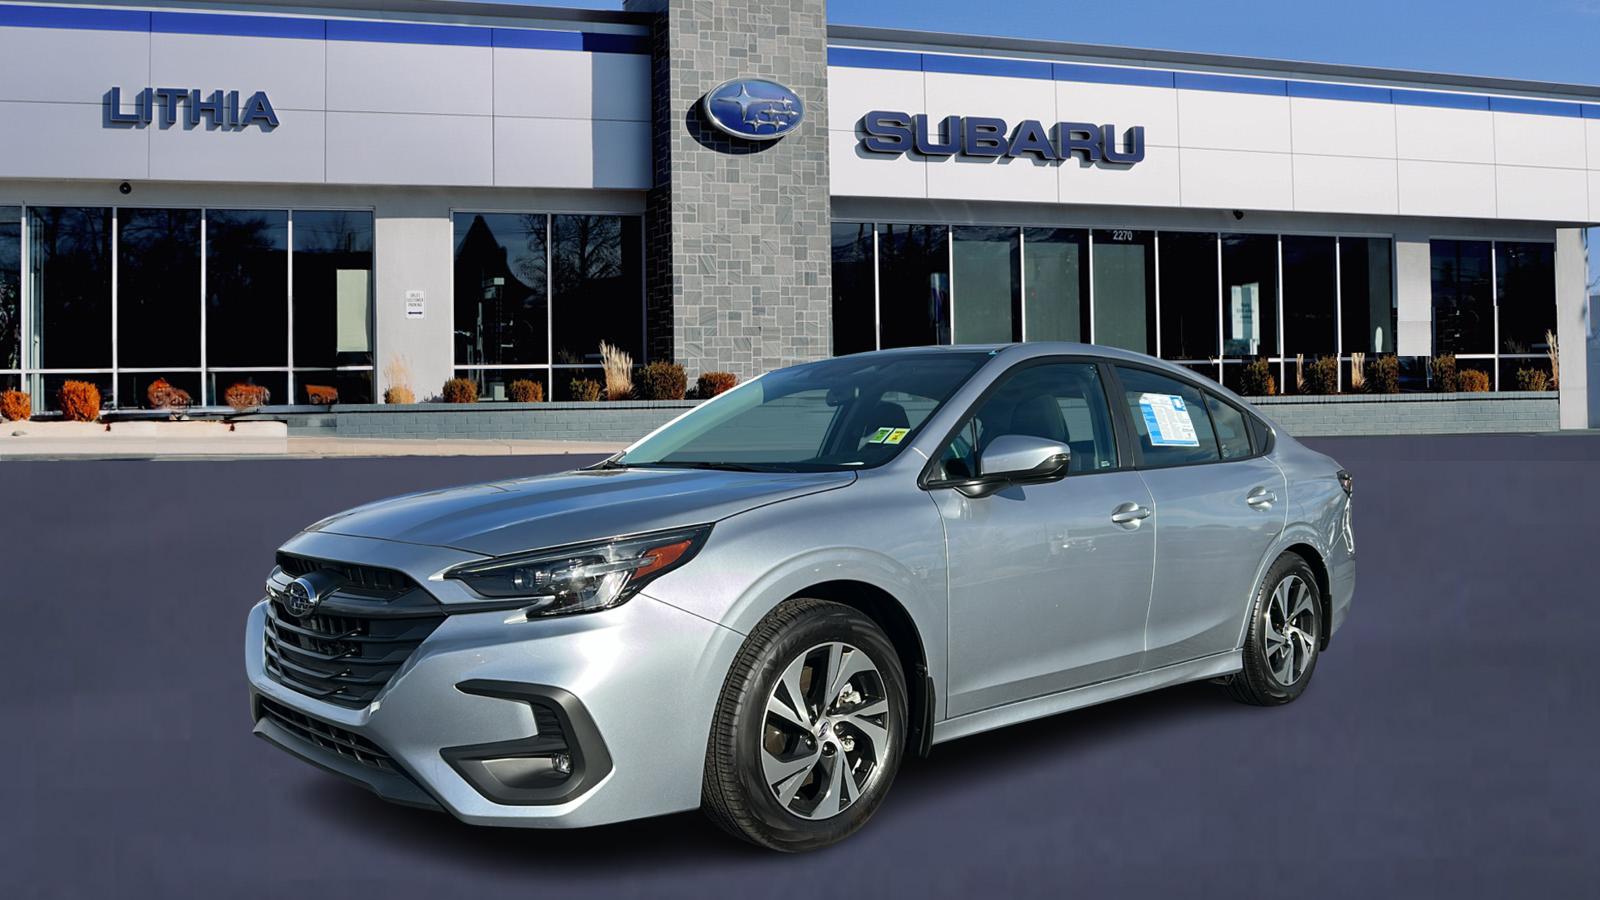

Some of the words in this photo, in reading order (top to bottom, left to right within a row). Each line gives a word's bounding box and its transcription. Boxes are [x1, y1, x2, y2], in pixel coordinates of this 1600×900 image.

[110, 86, 280, 127] LITHIA
[860, 110, 1145, 163] SUBARU
[1112, 230, 1133, 241] 2270
